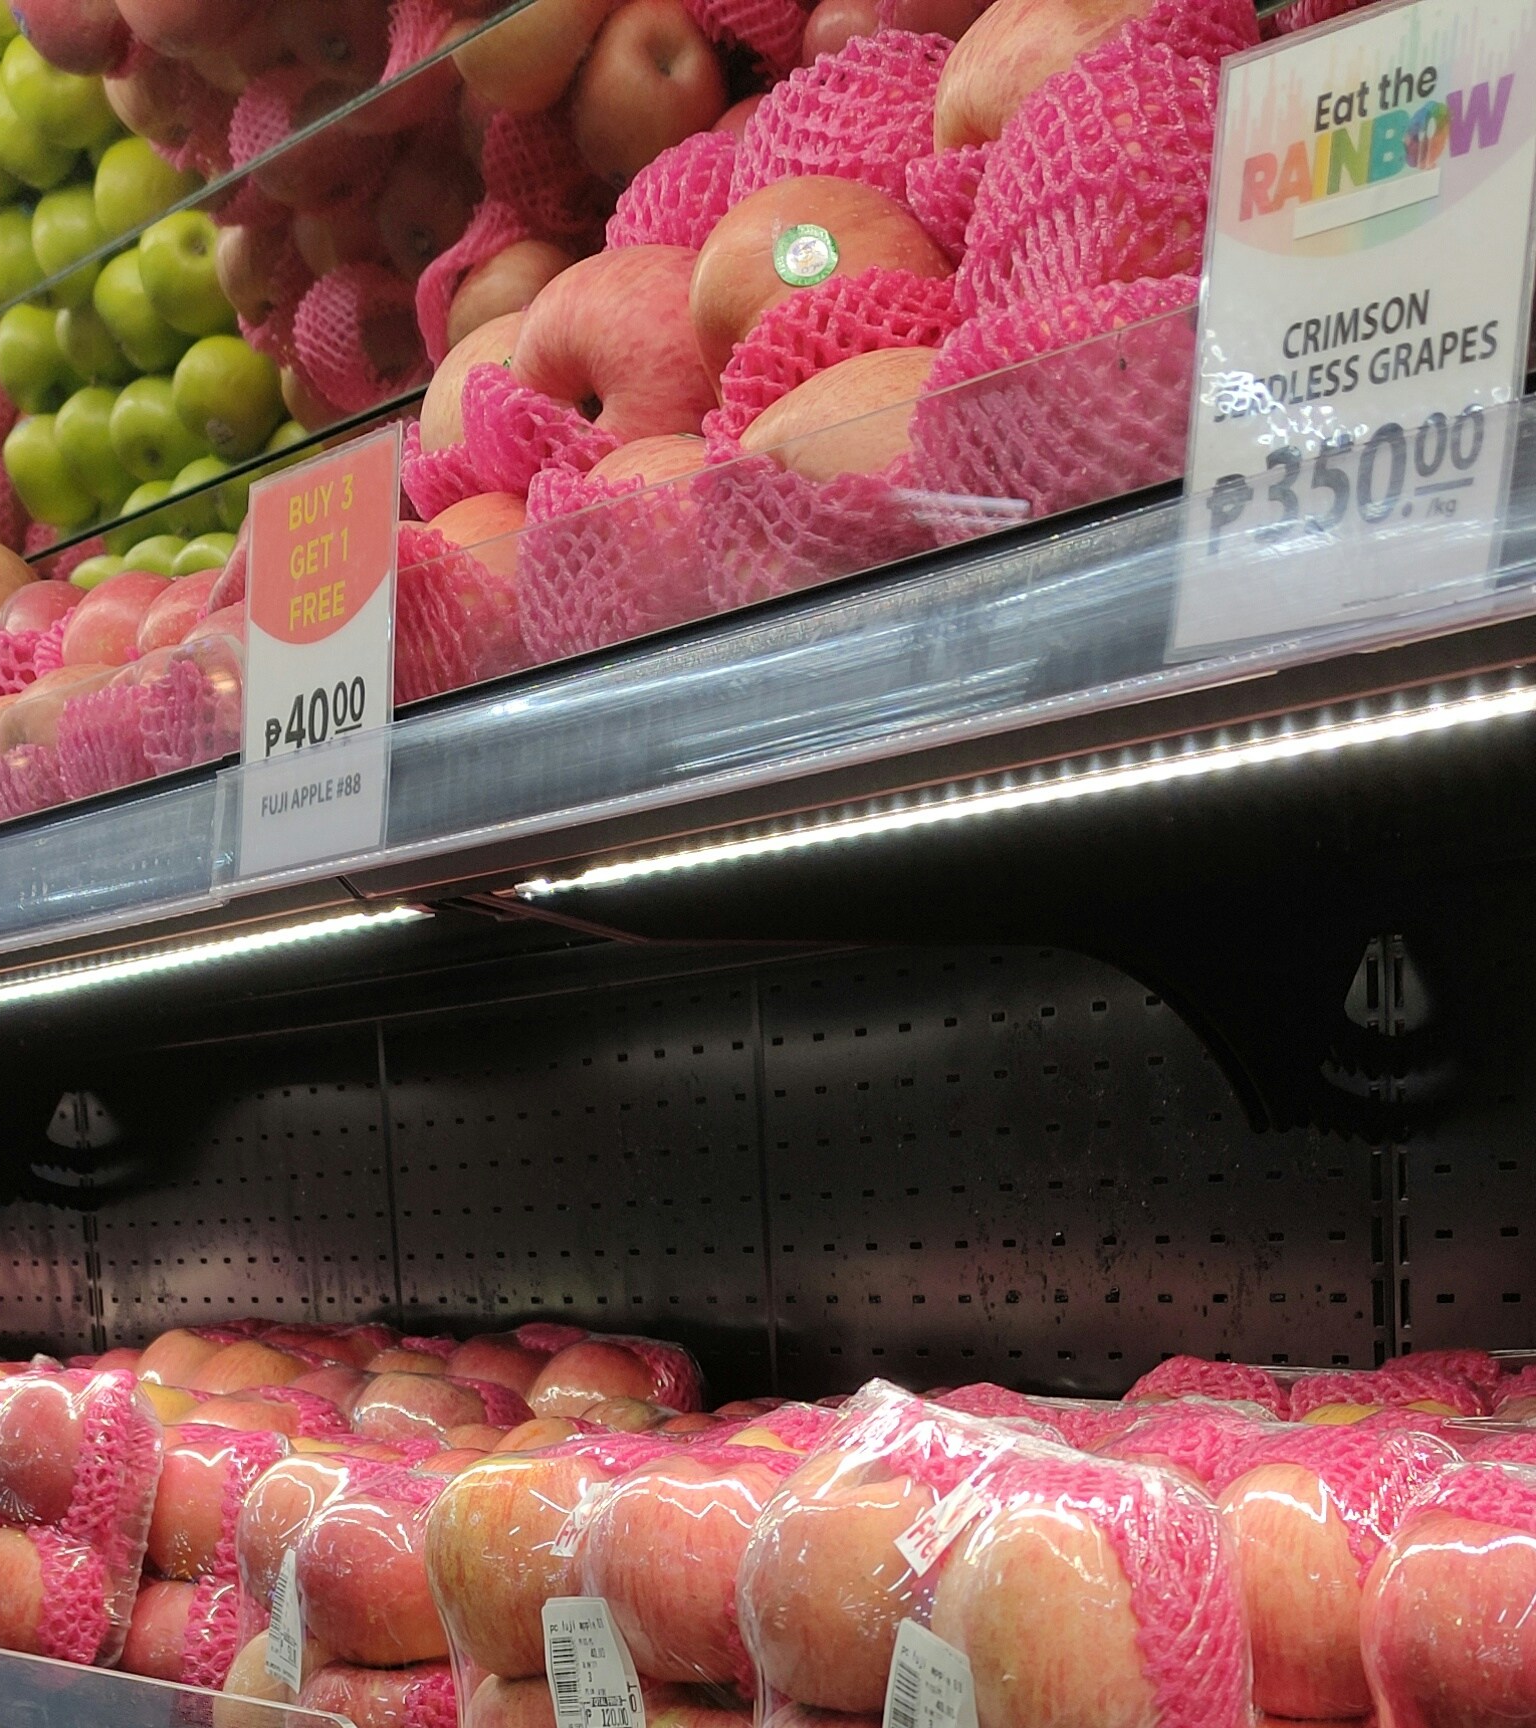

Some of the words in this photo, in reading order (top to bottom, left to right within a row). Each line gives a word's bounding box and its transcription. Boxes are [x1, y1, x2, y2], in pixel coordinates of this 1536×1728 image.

[1314, 82, 1369, 133] Eat
[1378, 66, 1437, 110] the
[1239, 73, 1514, 221] RAINBOW
[1283, 289, 1430, 359] CRIMSON
[1214, 355, 1360, 422] DLESS
[1368, 320, 1498, 385] GRAPES
[289, 481, 333, 531] BUY
[341, 474, 353, 510] 3
[290, 536, 333, 580] GET
[340, 528, 348, 562] 1
[289, 581, 346, 632] FREE
[262, 796, 288, 817] FUJI
[291, 777, 333, 809] APPLE
[336, 773, 361, 802] #88
